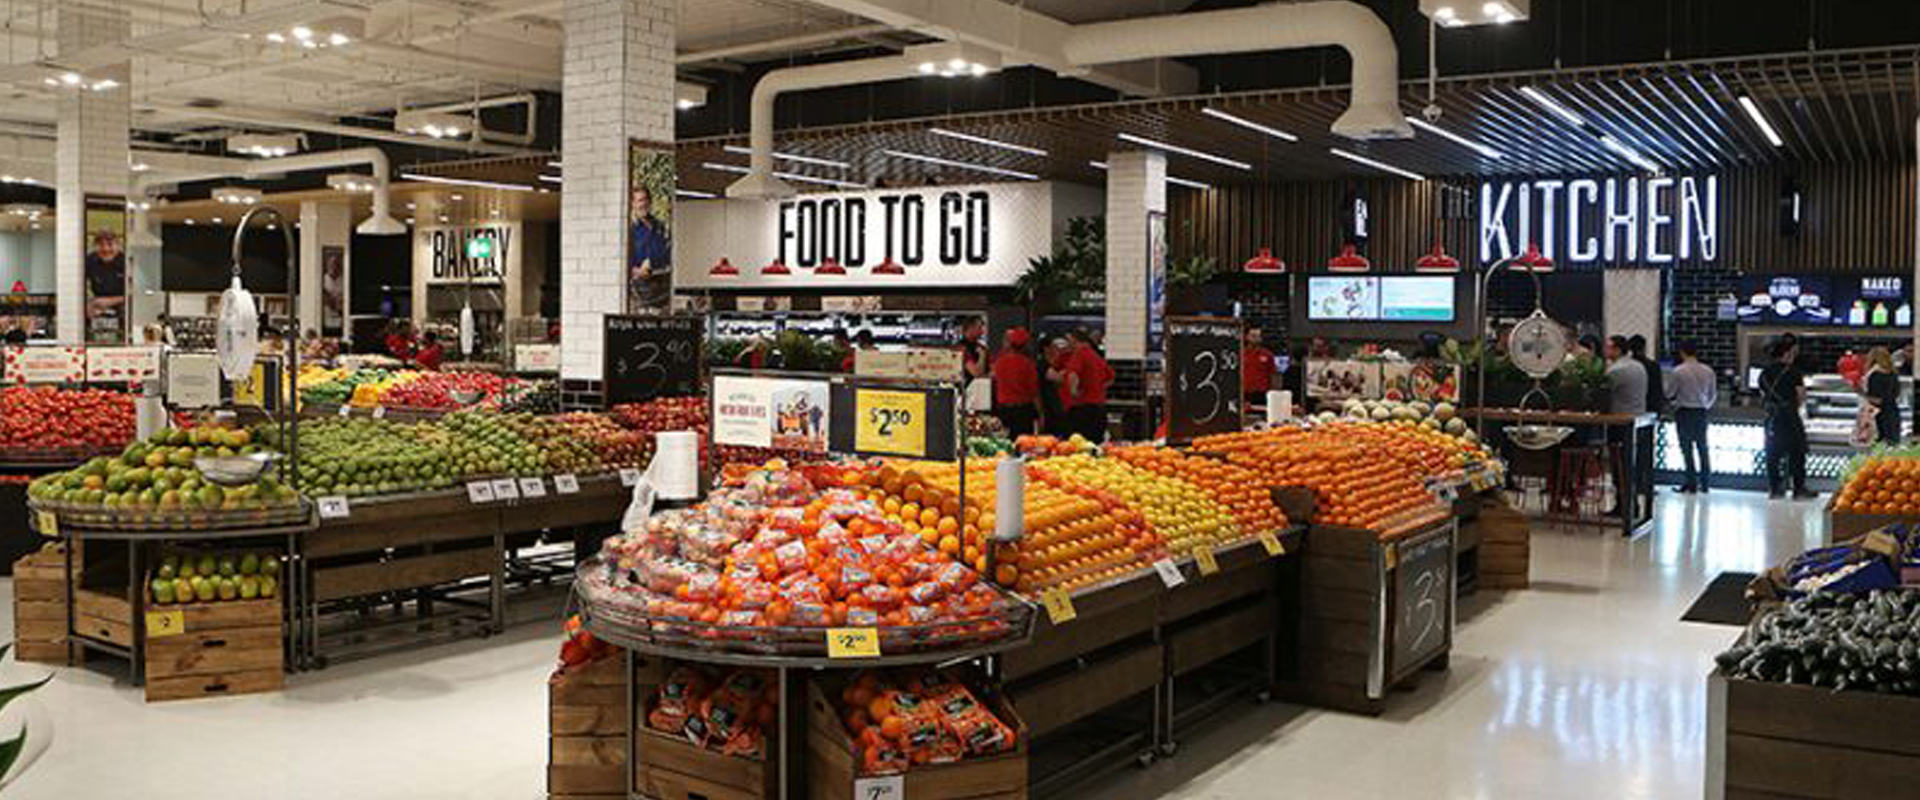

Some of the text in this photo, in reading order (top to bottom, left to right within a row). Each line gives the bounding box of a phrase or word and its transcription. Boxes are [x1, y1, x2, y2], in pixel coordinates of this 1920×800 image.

[779, 191, 990, 267] FOOD TO GO
[1480, 175, 1717, 262] KITCHEN
